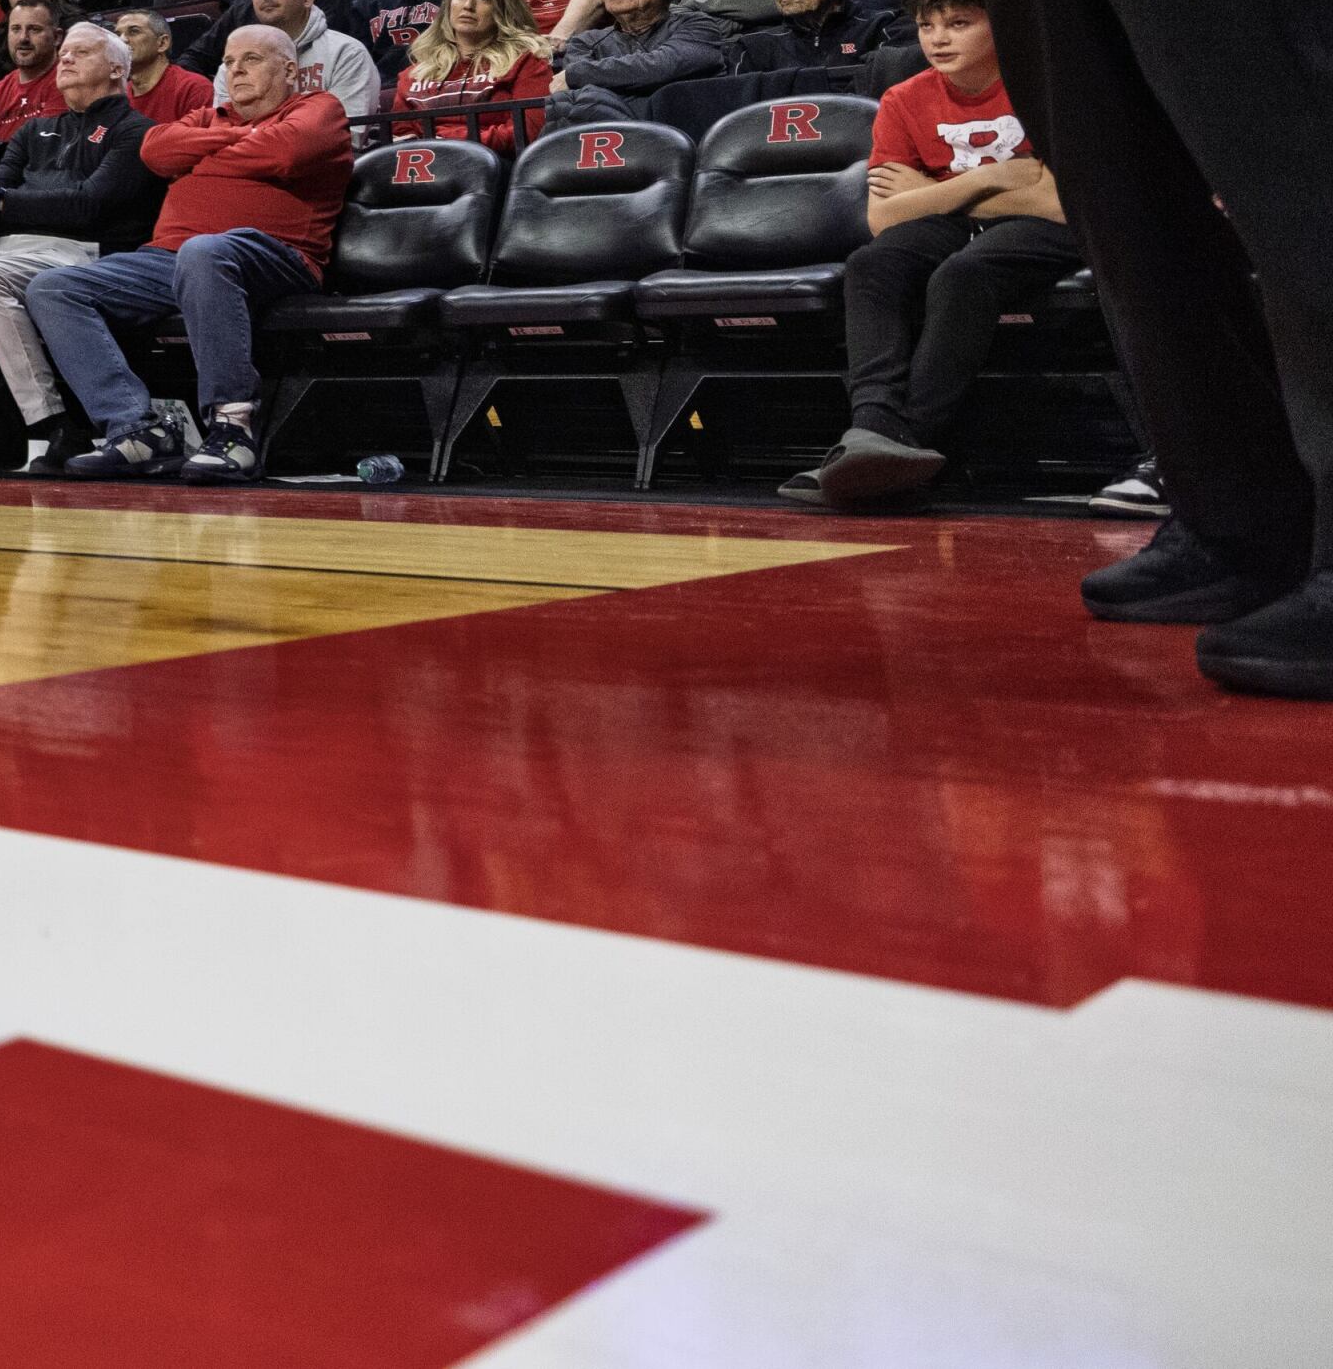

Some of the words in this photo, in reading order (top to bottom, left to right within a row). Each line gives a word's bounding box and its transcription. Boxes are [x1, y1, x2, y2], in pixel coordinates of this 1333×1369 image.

[767, 102, 822, 143] R
[577, 131, 626, 169] R
[937, 115, 1025, 172] R
[392, 149, 436, 184] R
